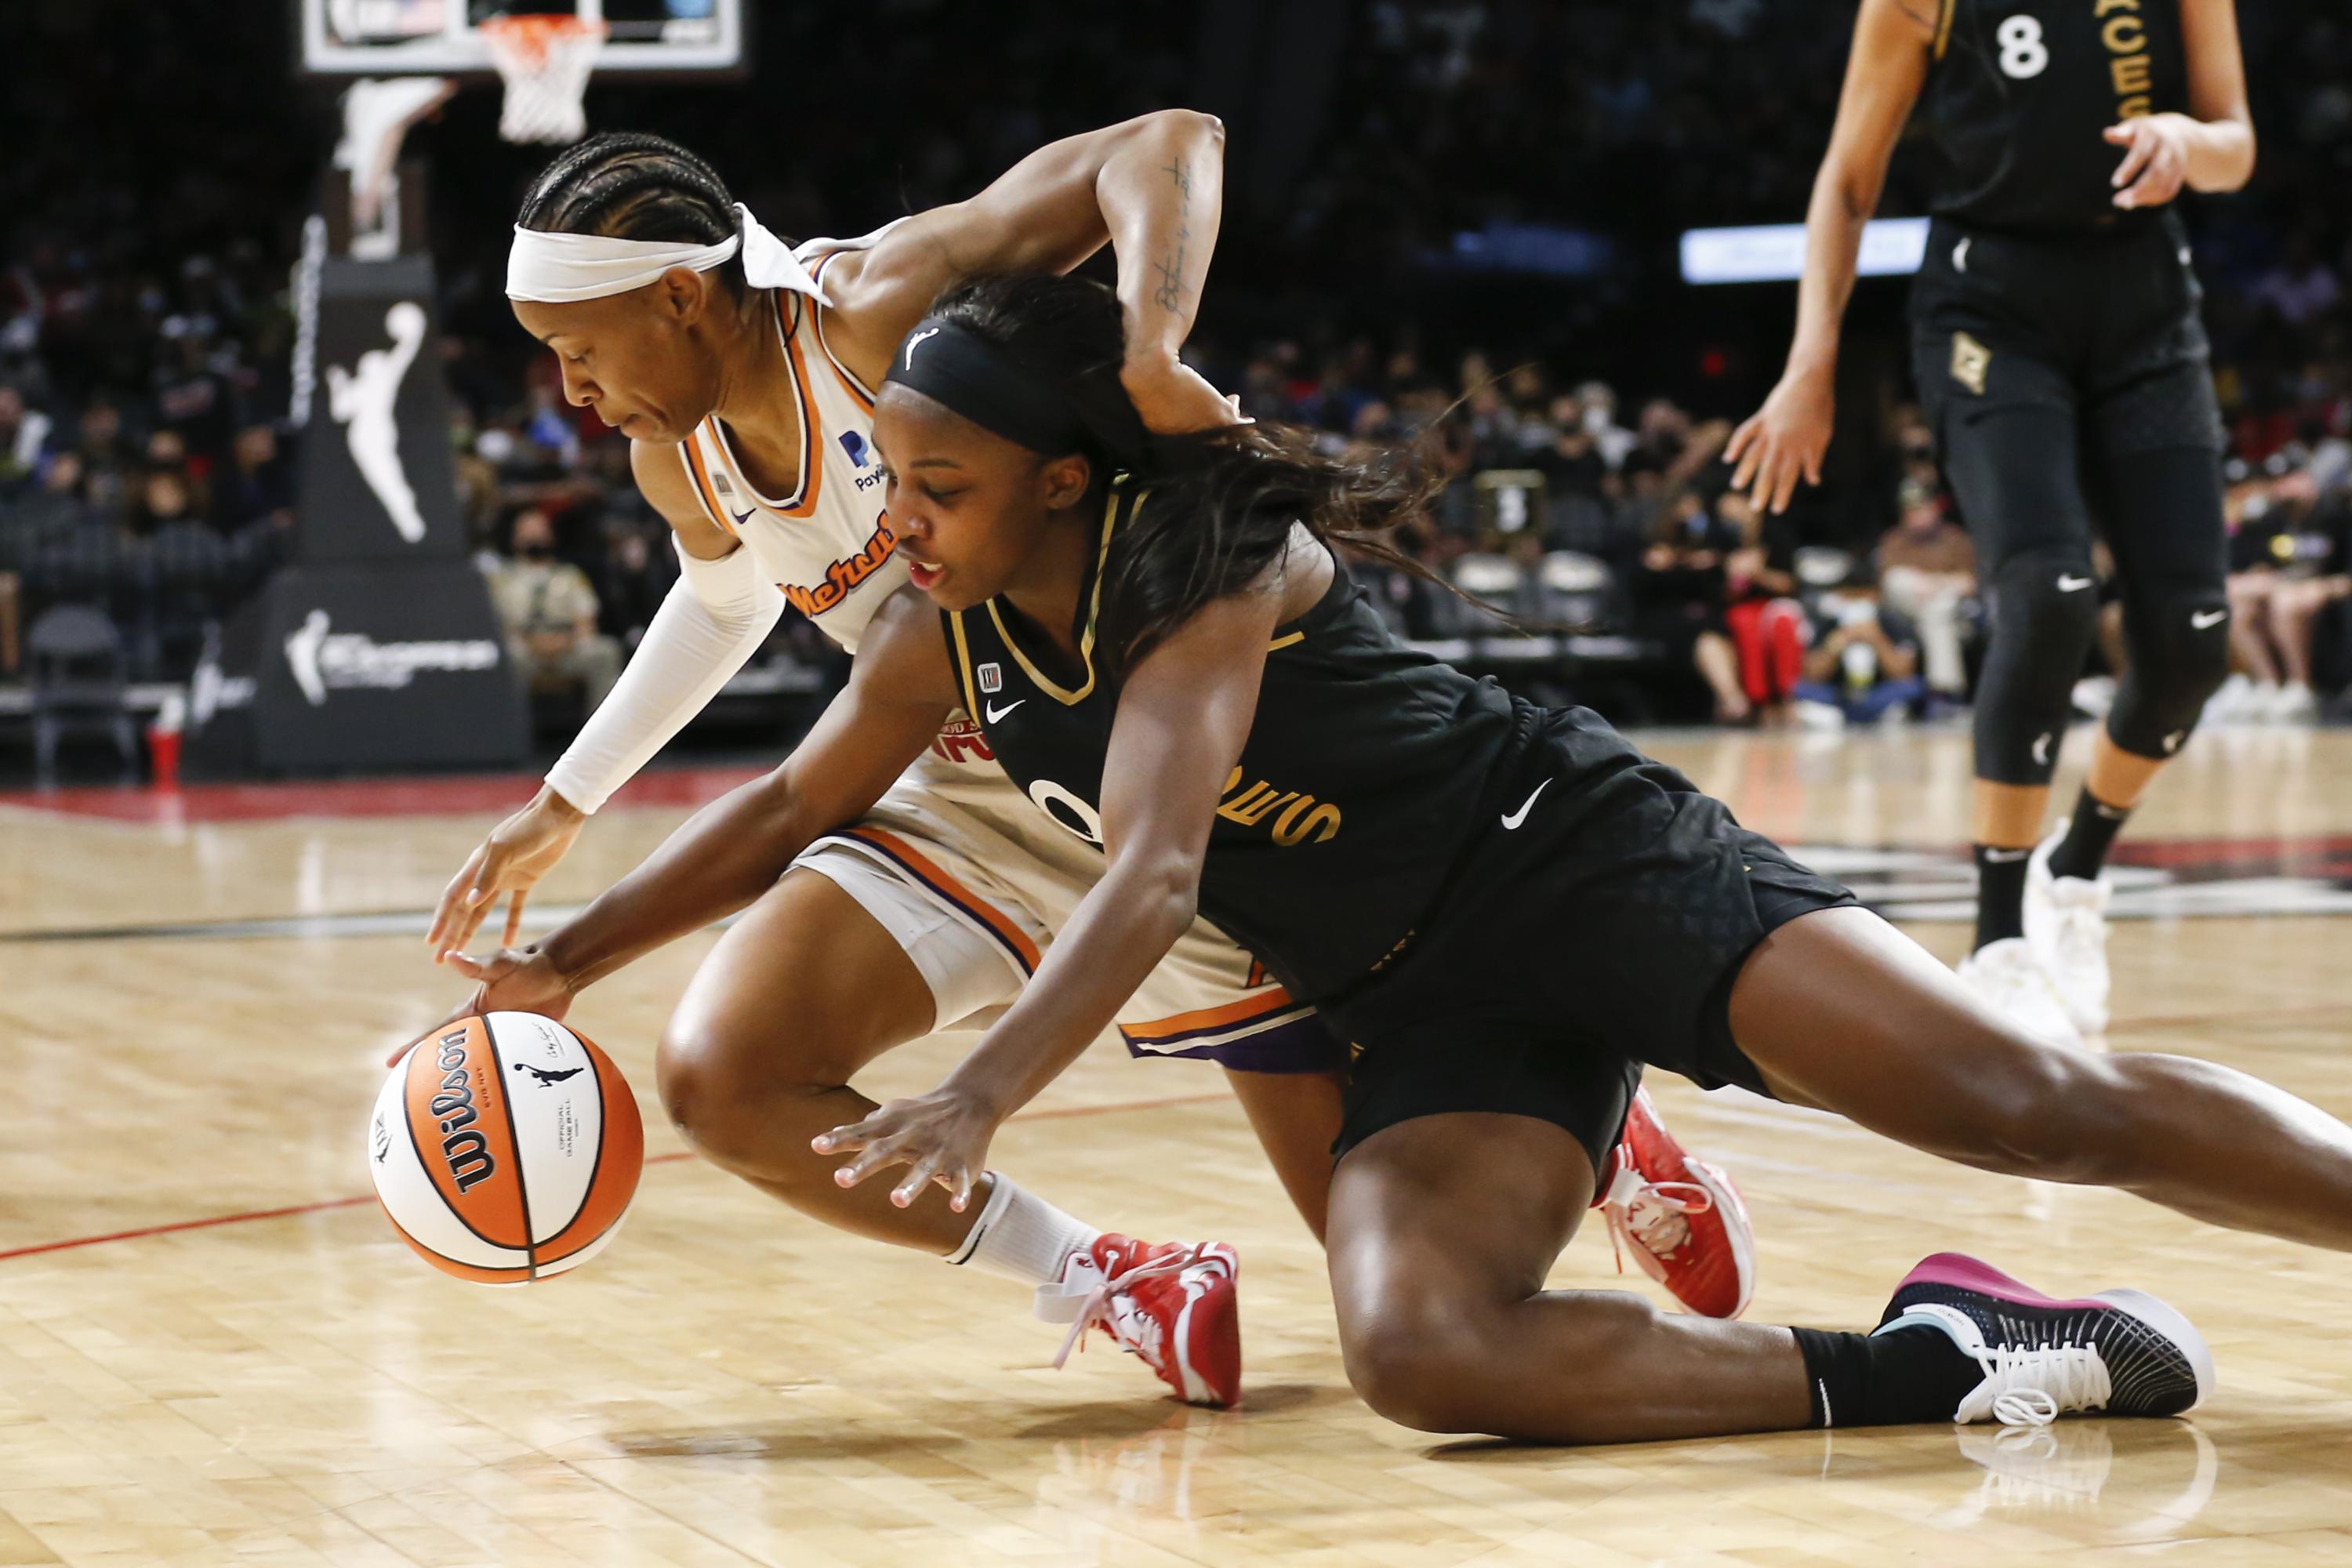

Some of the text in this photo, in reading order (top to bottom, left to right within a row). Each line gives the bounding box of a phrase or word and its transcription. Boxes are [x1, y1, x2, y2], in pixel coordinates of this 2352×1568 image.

[1996, 14, 2049, 79] 8
[855, 463, 886, 492] Pay
[775, 508, 899, 618] Mercu
[428, 1026, 495, 1196] Wilson
